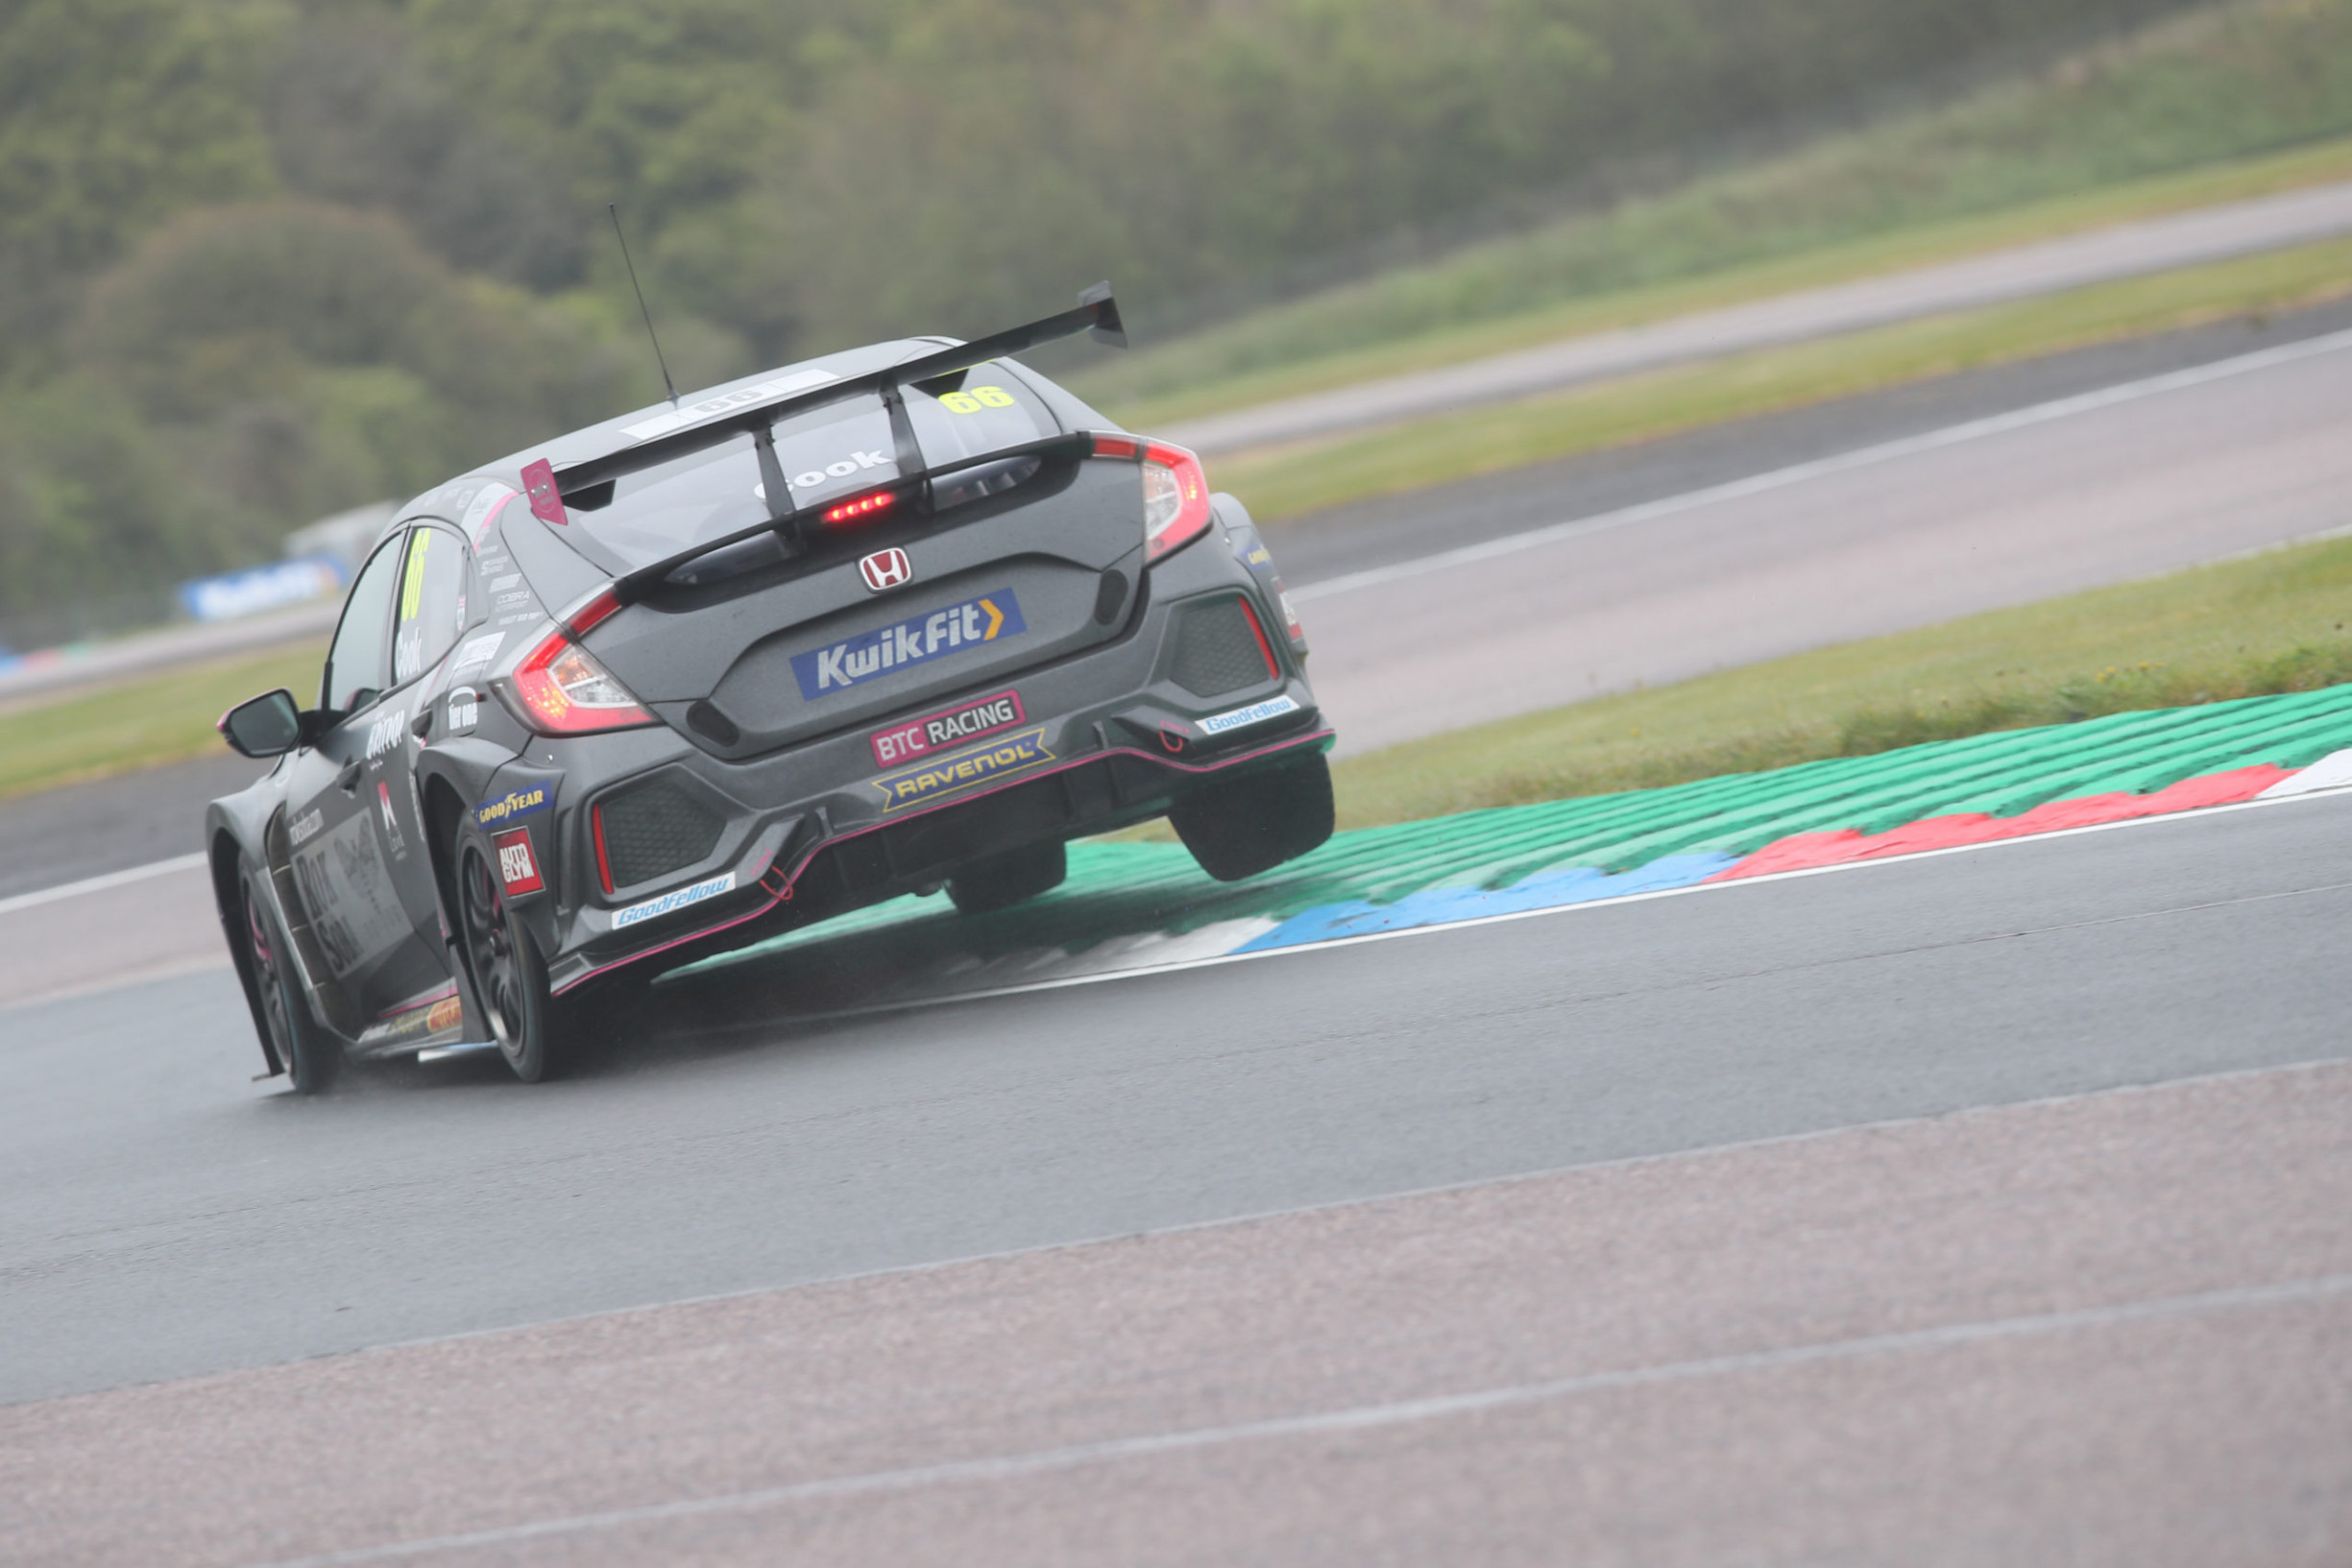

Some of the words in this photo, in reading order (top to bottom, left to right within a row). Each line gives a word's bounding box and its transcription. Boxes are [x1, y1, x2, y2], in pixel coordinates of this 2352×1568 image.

[938, 386, 1015, 414] 66
[876, 727, 925, 761] BTC
[927, 699, 1014, 745] RACING
[894, 744, 1035, 798] RAVENOL
[499, 842, 530, 864] AUTO
[501, 859, 535, 883] GLYM
